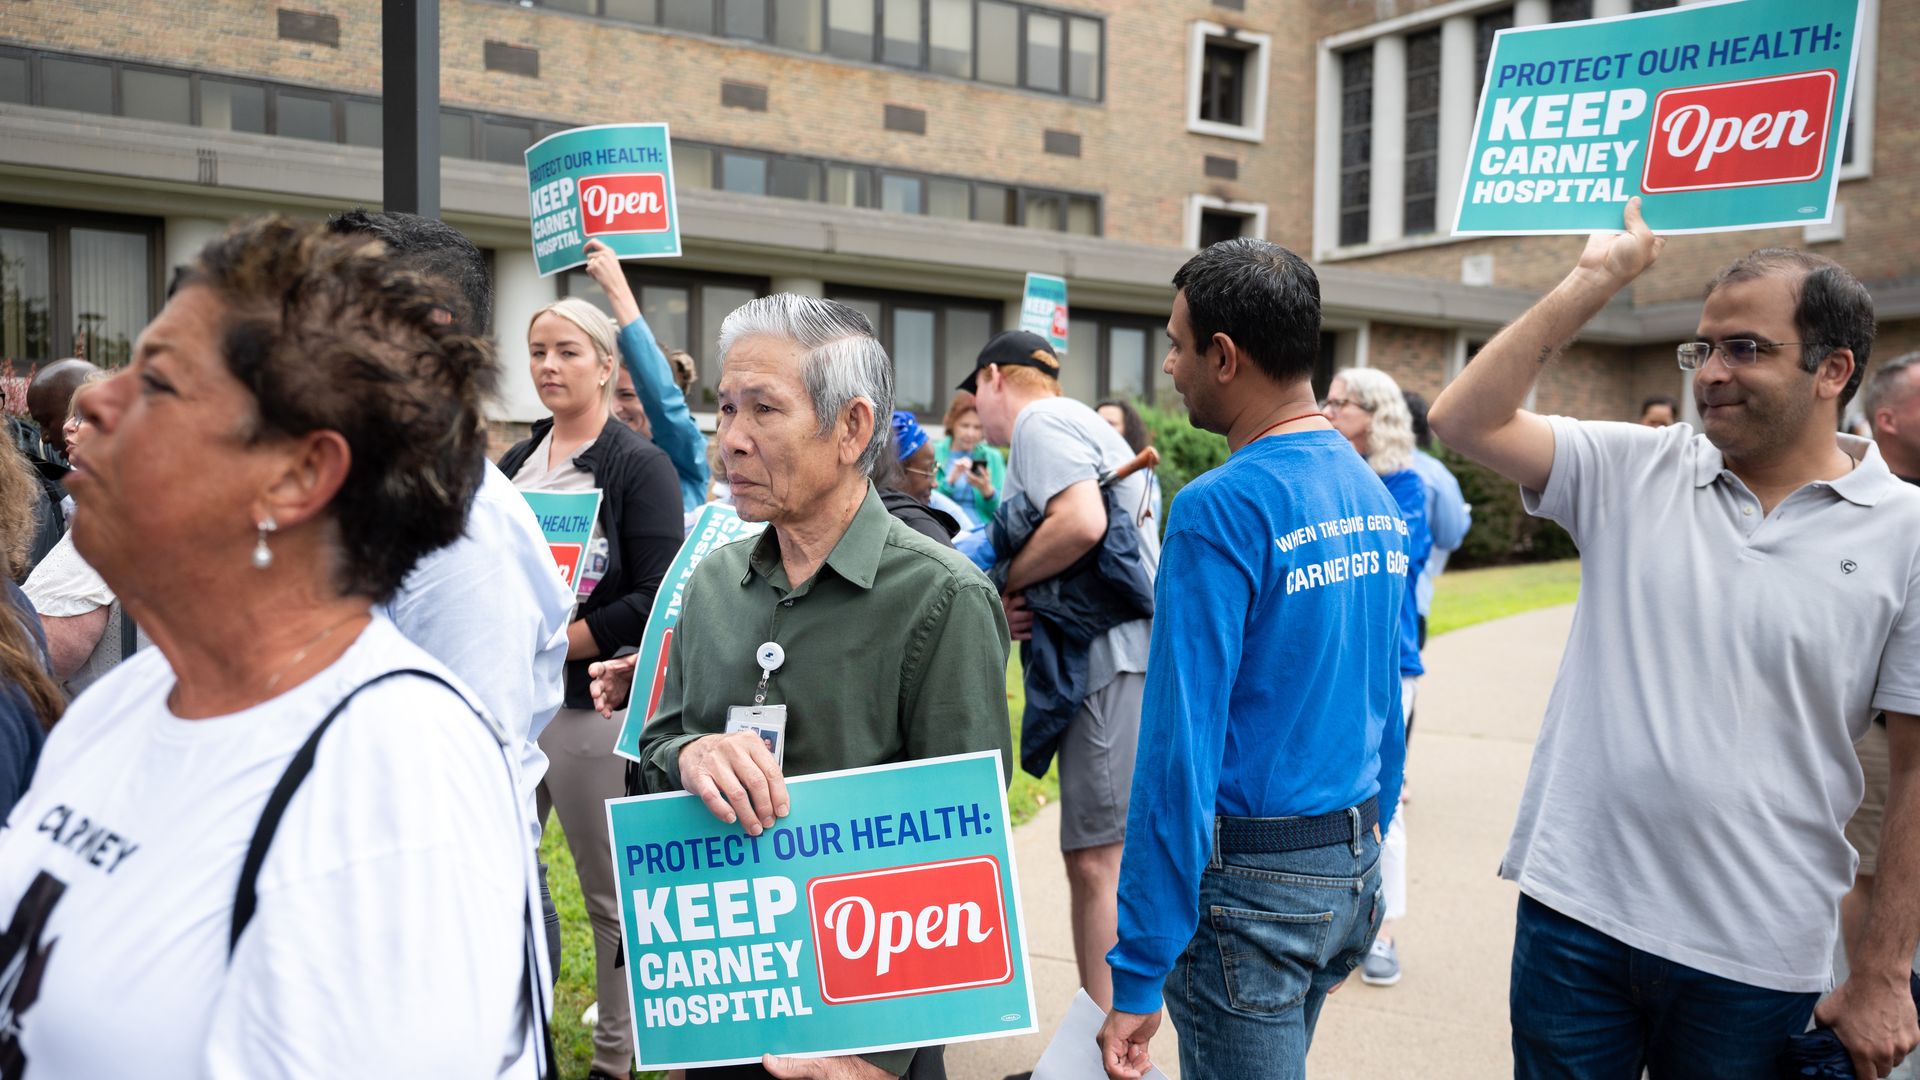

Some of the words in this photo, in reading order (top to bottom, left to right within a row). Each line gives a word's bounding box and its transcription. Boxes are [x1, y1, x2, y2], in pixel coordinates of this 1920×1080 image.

[1498, 53, 1632, 88] PROTECT
[1638, 44, 1699, 76] OUR
[1707, 23, 1842, 67] HEALTH:
[1488, 88, 1647, 141] KEEP
[1480, 140, 1639, 176] CARNEY
[1662, 104, 1815, 172] Open
[530, 157, 562, 184] PROTECT
[564, 151, 592, 171] OUR
[596, 147, 663, 165] HEALTH:
[531, 177, 575, 219] KEEP
[583, 185, 662, 224] Open
[1472, 177, 1630, 204] HOSPITAL
[533, 207, 577, 240] CARNEY
[535, 230, 581, 258] HOSPITAL
[541, 514, 590, 533] HEALTH:
[1275, 525, 1317, 552] WHEN
[1318, 519, 1340, 538] THE
[1367, 515, 1392, 531] GETS
[1286, 555, 1350, 595] CARNEY
[37, 804, 140, 874] CARNEY
[627, 831, 764, 876] PROTECT
[774, 822, 842, 862] OUR
[850, 803, 993, 852] HEALTH:
[632, 875, 797, 945] KEEP
[824, 896, 993, 977] Open
[639, 940, 803, 990] CARNEY
[644, 986, 813, 1028] HOSPITAL
